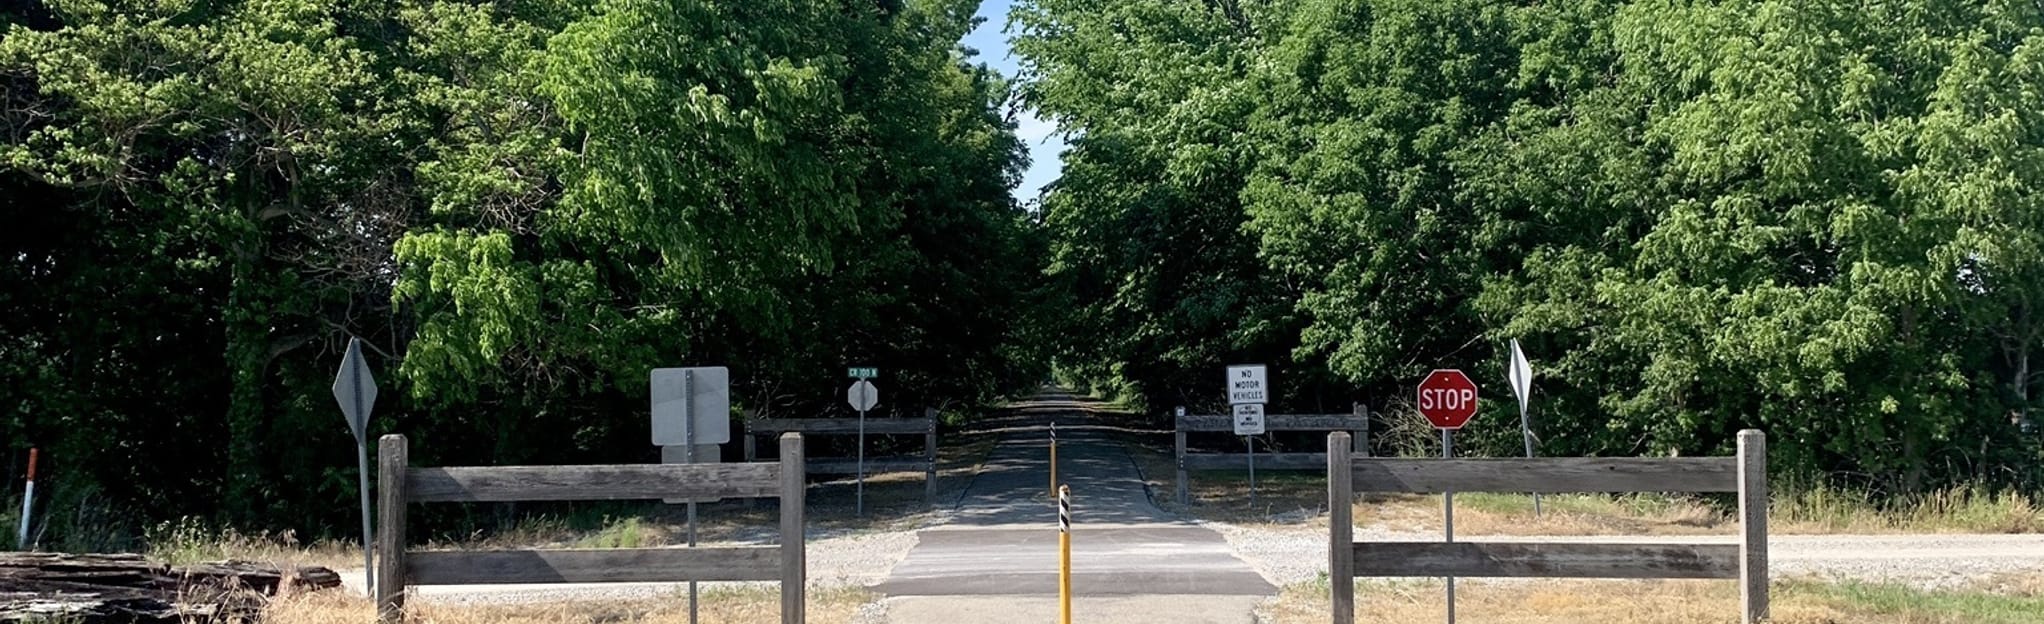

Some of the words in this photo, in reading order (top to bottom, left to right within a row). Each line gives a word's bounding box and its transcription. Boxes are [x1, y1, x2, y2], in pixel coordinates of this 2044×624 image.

[1241, 370, 1252, 378] NO
[1234, 380, 1260, 389] MOTOR
[1233, 391, 1263, 400] VEHICLES
[1422, 388, 1473, 410] STOP
